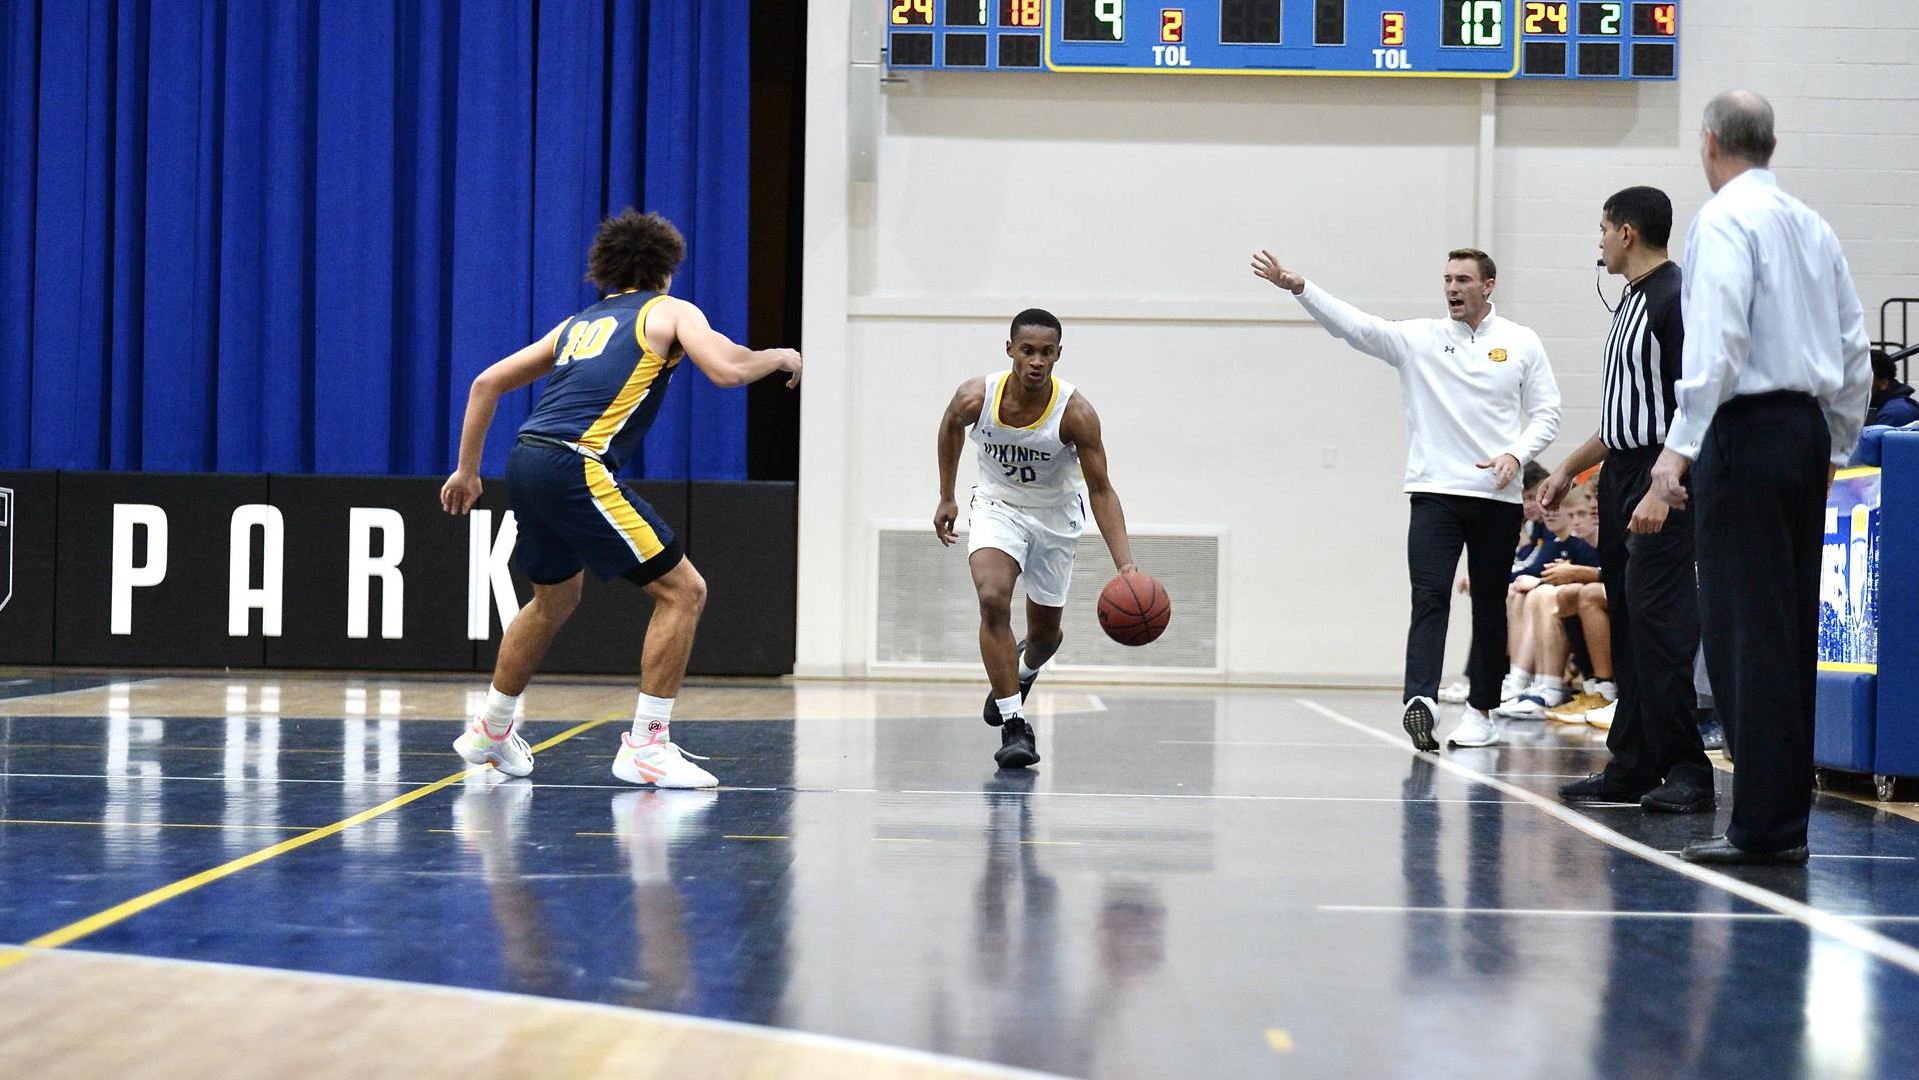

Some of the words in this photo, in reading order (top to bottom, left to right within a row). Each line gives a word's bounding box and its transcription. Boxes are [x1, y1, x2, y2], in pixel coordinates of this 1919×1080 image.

[892, 0, 933, 24] 24
[1011, 0, 1041, 26] 18
[1094, 0, 1122, 40] 9
[1162, 11, 1183, 41] 2
[1460, 0, 1502, 45] 10
[1525, 2, 1568, 34] 24
[1600, 4, 1621, 34] 2
[1654, 5, 1675, 35] 4
[1383, 14, 1404, 45] 3
[1152, 46, 1191, 66] TOL
[1372, 49, 1412, 69] TOL
[555, 316, 619, 366] 10
[110, 503, 520, 640] PARK
